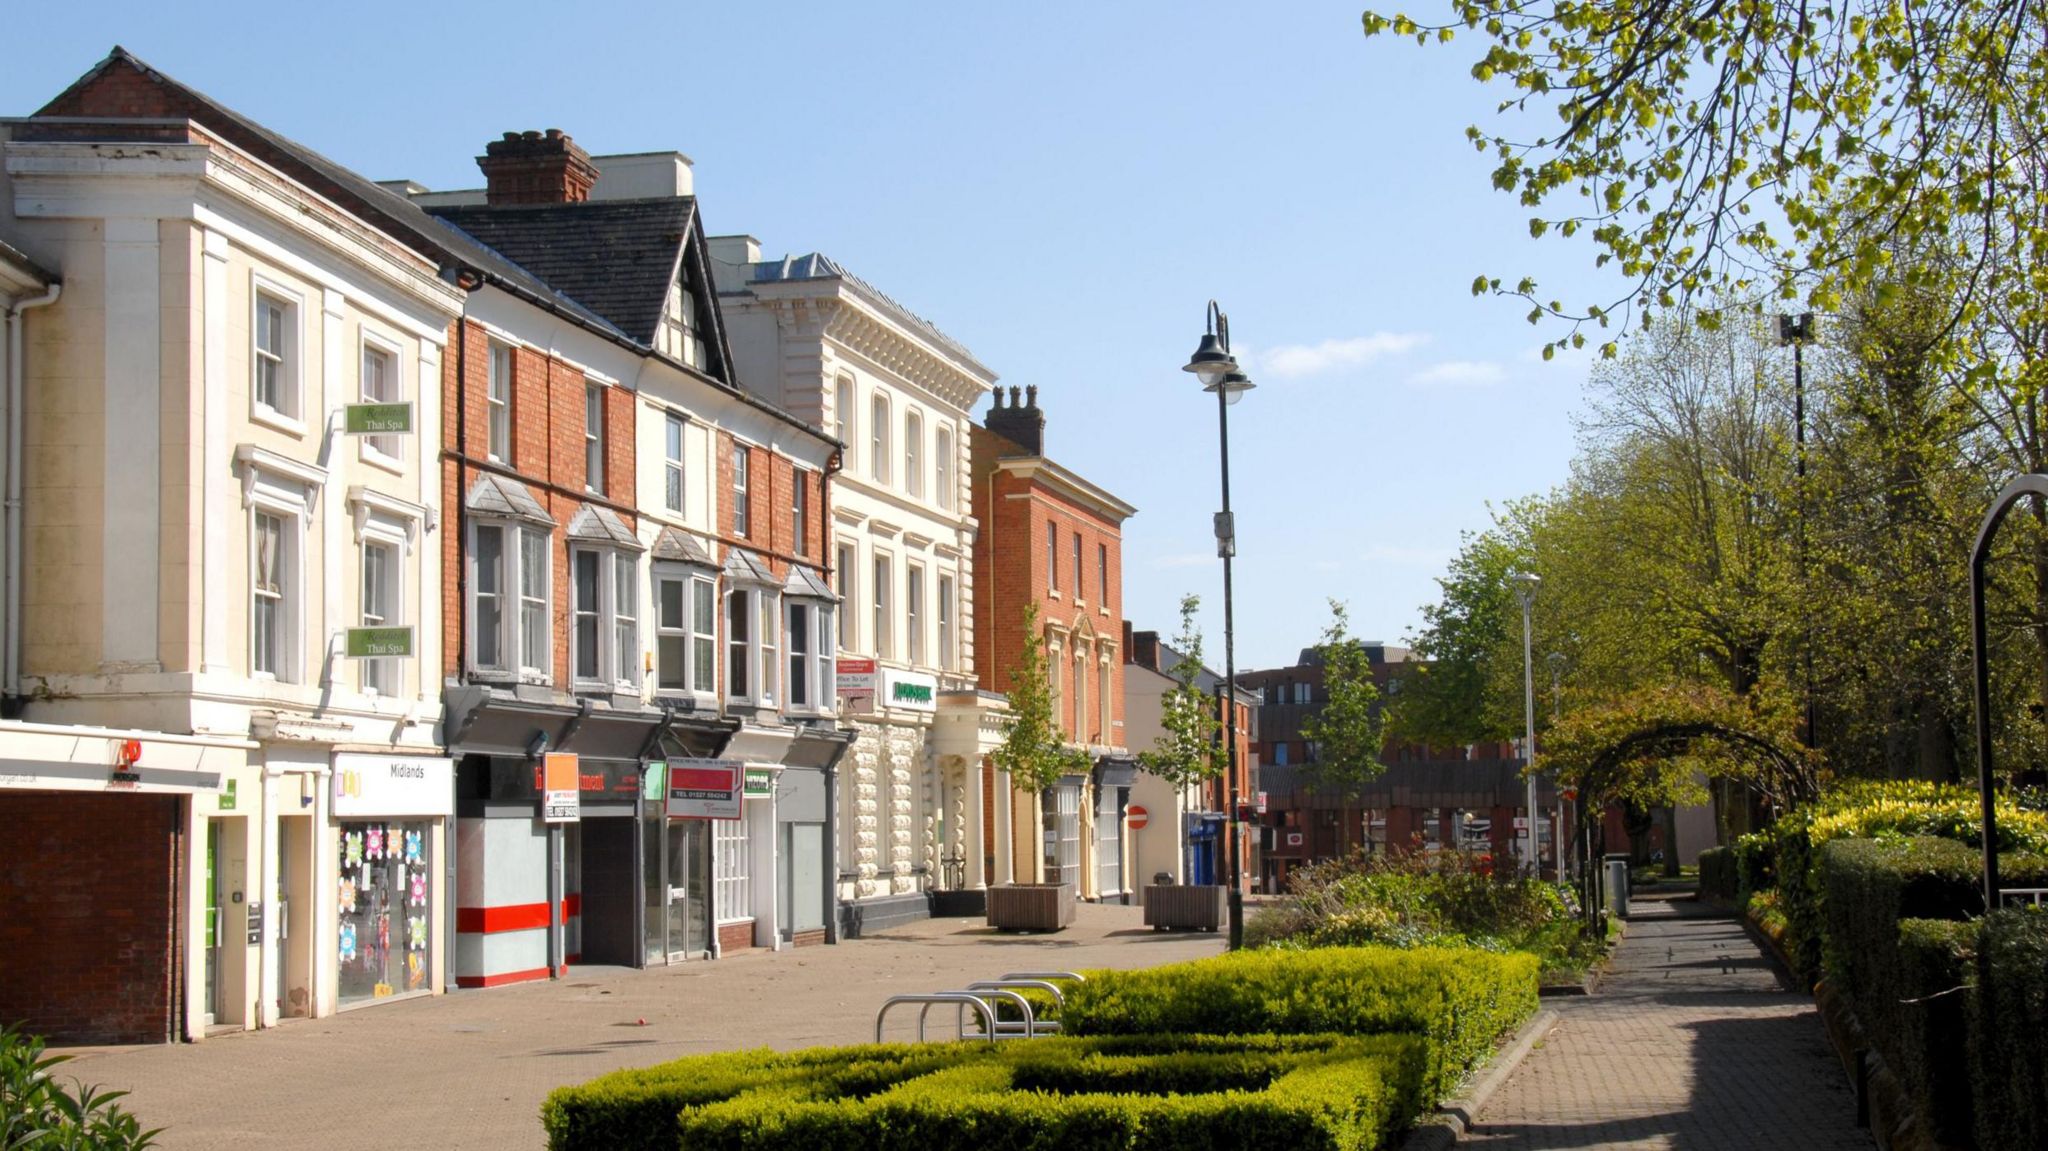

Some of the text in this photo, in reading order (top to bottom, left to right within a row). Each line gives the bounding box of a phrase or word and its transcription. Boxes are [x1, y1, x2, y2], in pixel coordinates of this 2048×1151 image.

[366, 420, 403, 431] Thai Spa
[366, 643, 404, 654] Thai Spa
[391, 763, 425, 779] Midlands
